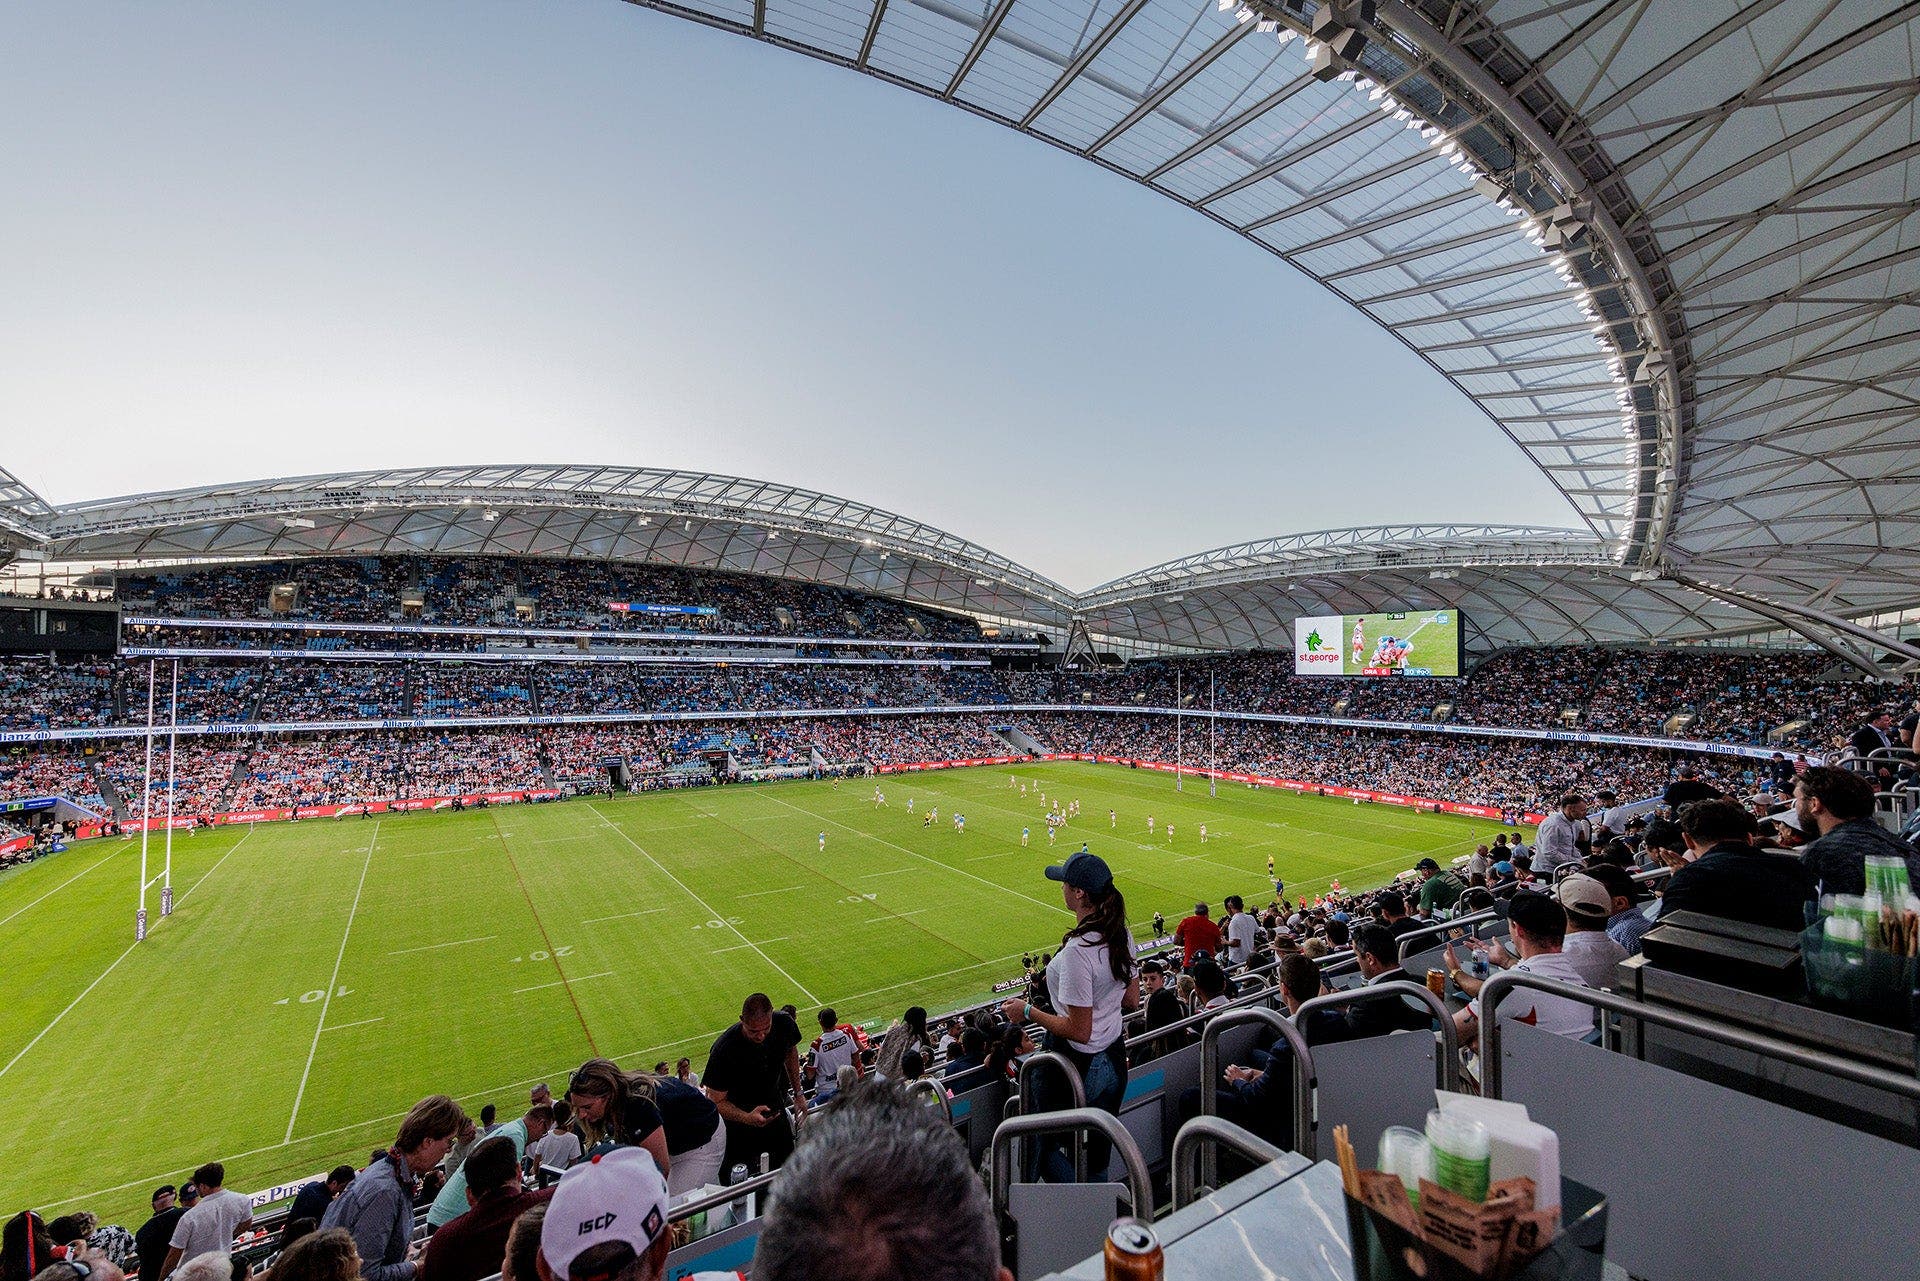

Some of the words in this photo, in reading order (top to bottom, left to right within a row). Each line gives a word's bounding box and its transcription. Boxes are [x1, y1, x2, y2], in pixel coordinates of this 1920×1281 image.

[1300, 652, 1339, 663] st.george
[382, 720, 413, 728] Allianz
[1304, 716, 1324, 724] Allianz
[1410, 723, 1434, 731] Allianz
[0, 733, 31, 741] lianz
[1546, 732, 1576, 741] Allianz
[1705, 744, 1735, 754] Allianz
[1381, 795, 1405, 803] st.george
[1458, 806, 1485, 815] st.george
[229, 813, 265, 821] st.george
[846, 893, 877, 903] 40
[705, 916, 745, 928] 30
[529, 945, 576, 961] 20
[299, 985, 356, 1003] 10
